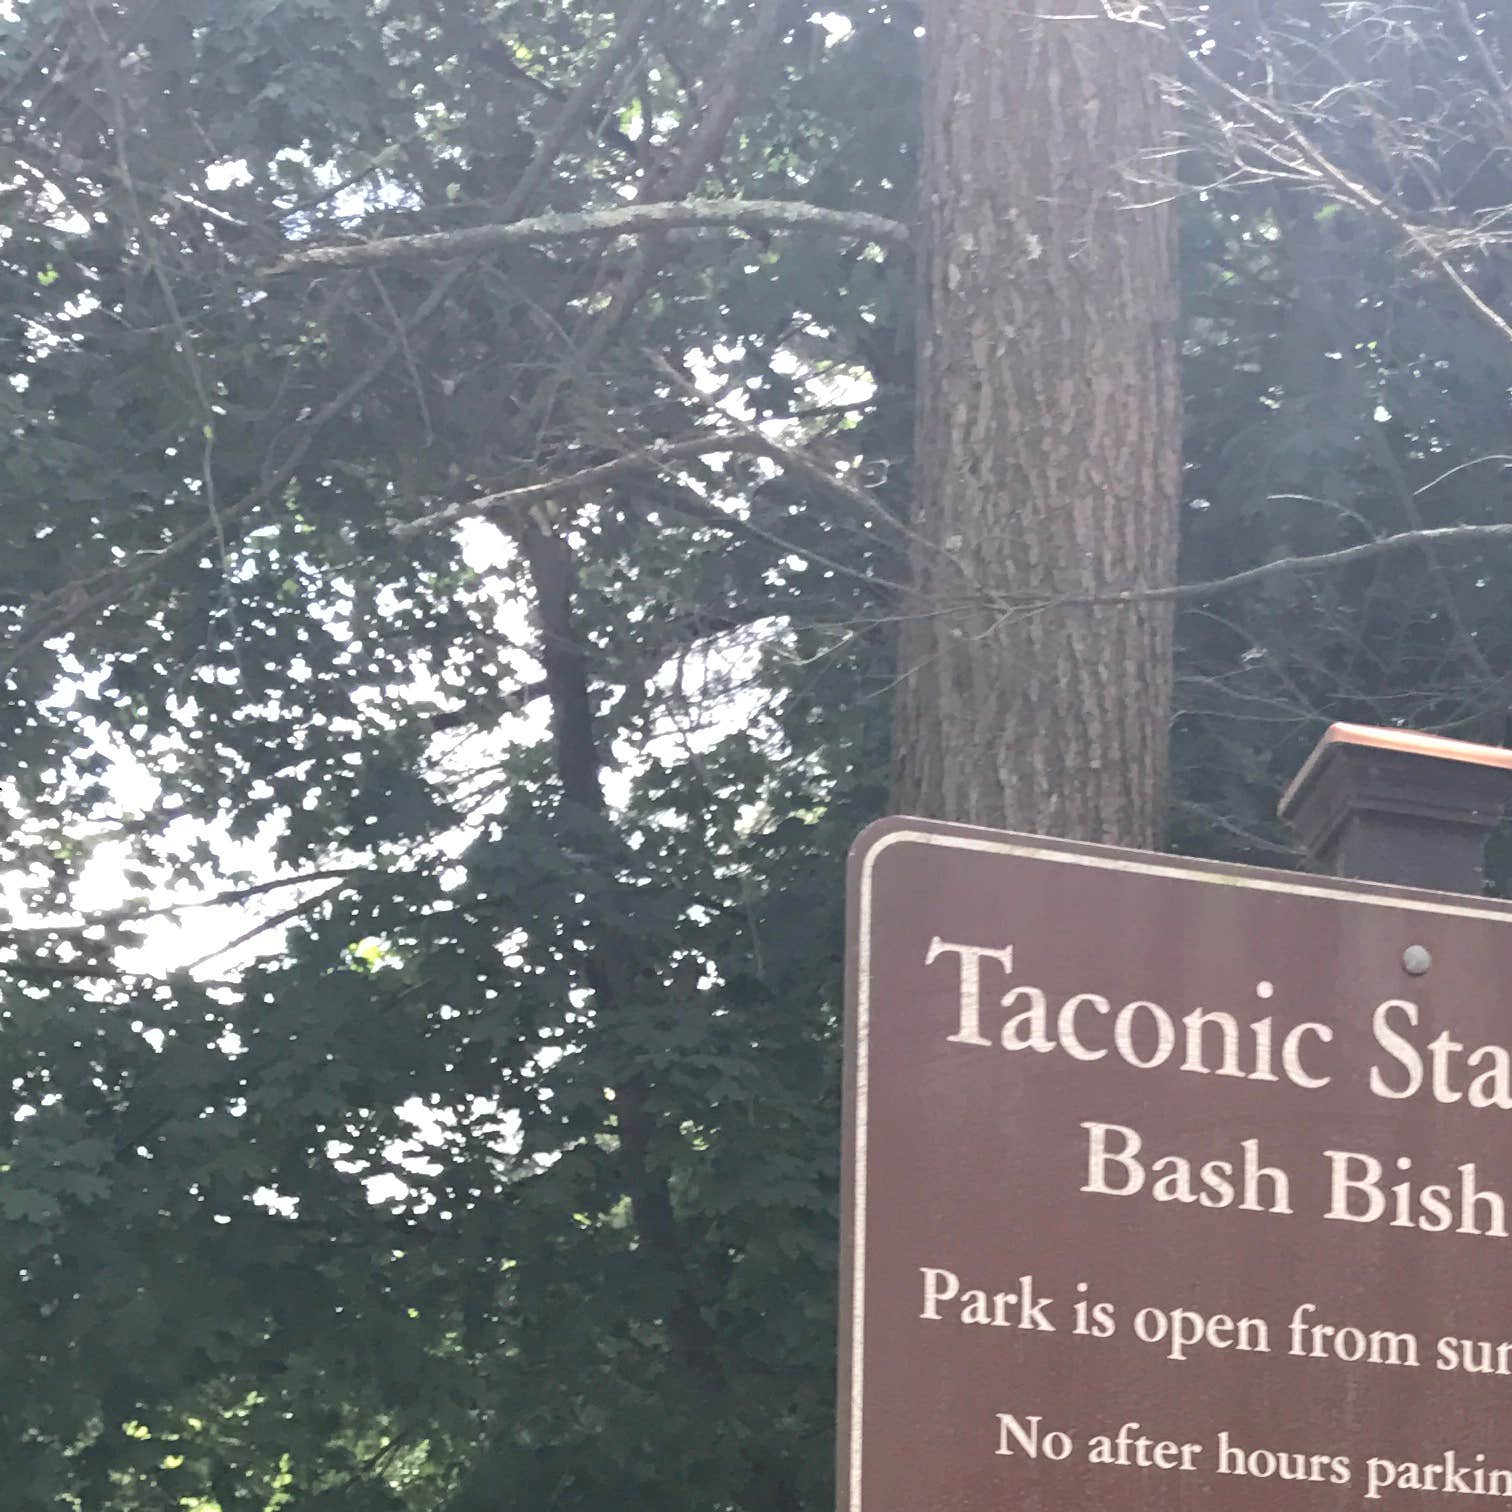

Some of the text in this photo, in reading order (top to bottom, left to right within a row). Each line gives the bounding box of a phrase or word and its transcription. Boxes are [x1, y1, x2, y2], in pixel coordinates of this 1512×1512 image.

[925, 936, 1333, 1088] Taconic
[1080, 1122, 1293, 1214] Bash
[1323, 1150, 1509, 1237] Bish
[920, 1267, 1056, 1331] Park
[1072, 1283, 1115, 1337] is
[1134, 1308, 1271, 1360] open
[1288, 1304, 1420, 1366] from
[995, 1413, 1073, 1460] No
[1088, 1422, 1203, 1470] after
[1216, 1432, 1351, 1483] hours
